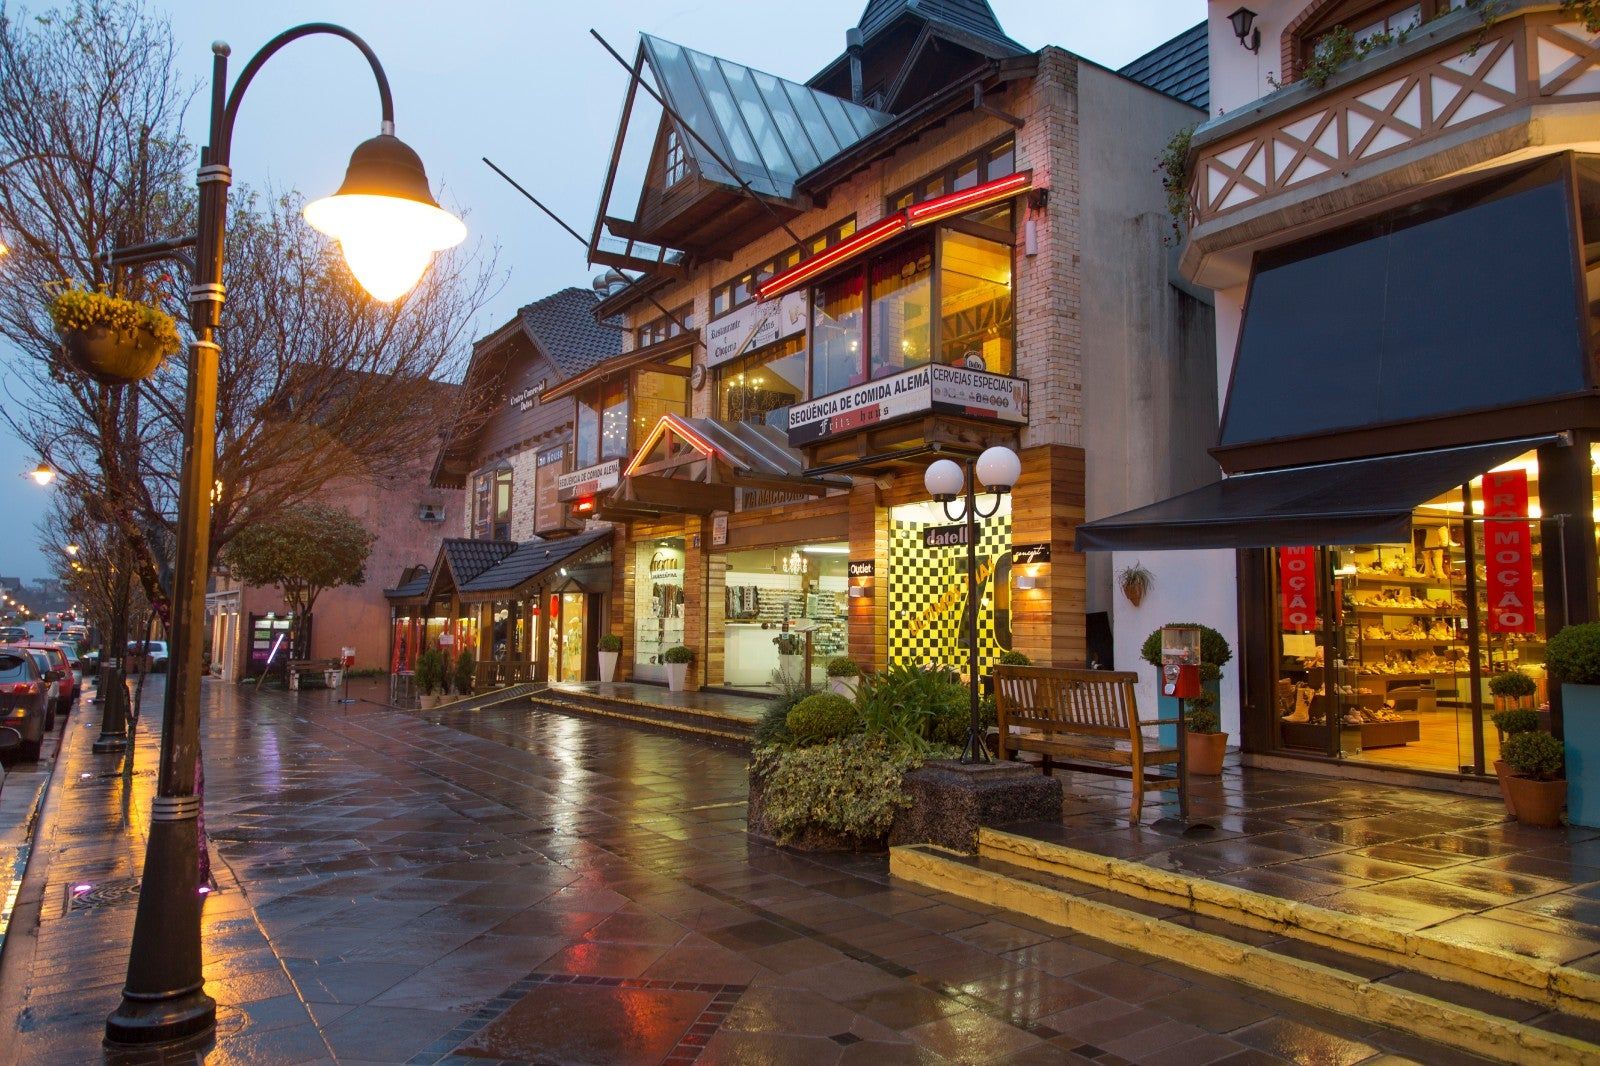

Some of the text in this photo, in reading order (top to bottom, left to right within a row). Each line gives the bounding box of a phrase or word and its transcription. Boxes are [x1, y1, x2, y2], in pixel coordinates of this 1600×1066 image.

[840, 395, 852, 411] DE
[854, 383, 892, 407] COMIDA
[894, 368, 930, 395] ALEMÃ
[933, 368, 1013, 393] CERVEJAS ESPECIAIS
[860, 406, 889, 423] haus
[926, 526, 969, 546] datell
[1493, 475, 1525, 627] PROMOÇÃO
[850, 563, 872, 575] Outlet
